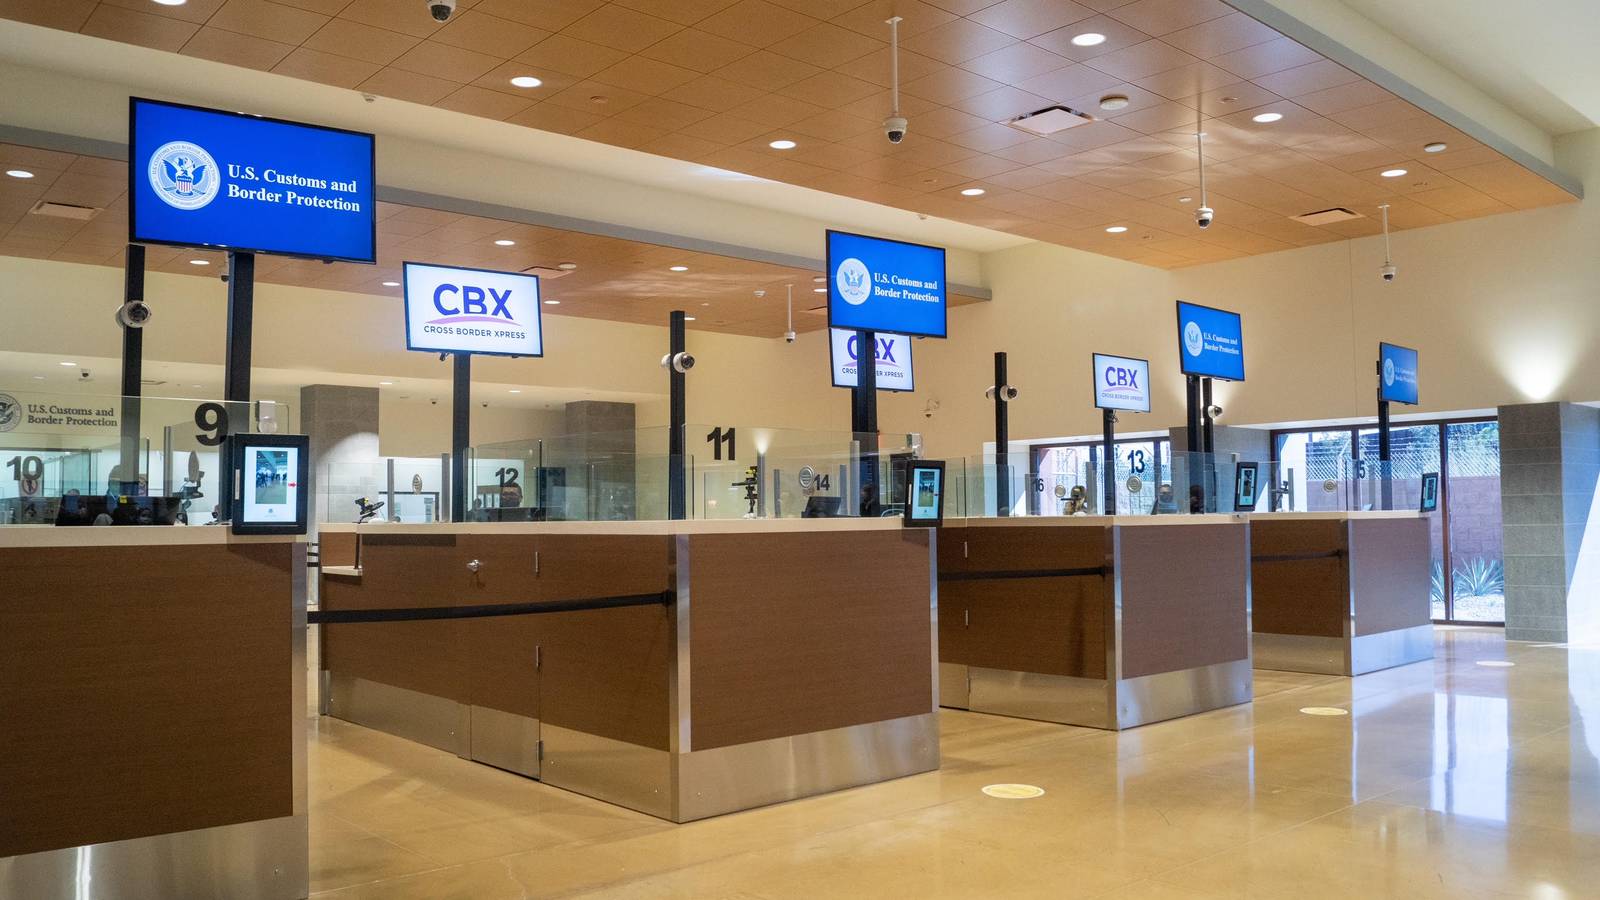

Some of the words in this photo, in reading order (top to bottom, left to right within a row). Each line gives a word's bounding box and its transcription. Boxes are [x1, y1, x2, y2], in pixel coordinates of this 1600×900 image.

[228, 163, 259, 180] U.S.
[264, 169, 327, 189] Customs
[331, 180, 356, 193] and
[228, 183, 282, 203] Border
[286, 190, 360, 212] Protection
[874, 272, 890, 284] U.S.
[891, 275, 923, 288] Customs
[924, 280, 938, 290] and
[433, 283, 514, 320] CBX
[874, 285, 901, 298] Border
[902, 289, 939, 303] Protection
[424, 325, 453, 335] CROSS
[456, 327, 491, 337] BORDER
[494, 330, 526, 339] XPRESS
[1105, 366, 1138, 389] CBX
[28, 404, 47, 414] U.S.
[49, 405, 93, 416] Customs
[95, 407, 114, 416] and
[28, 415, 63, 425] Border
[66, 416, 118, 427] Protection
[195, 402, 228, 446] 9
[707, 426, 735, 460] 11
[6, 455, 43, 481] 10
[1127, 449, 1145, 474] 13
[495, 467, 519, 487] 12
[813, 474, 830, 491] 14
